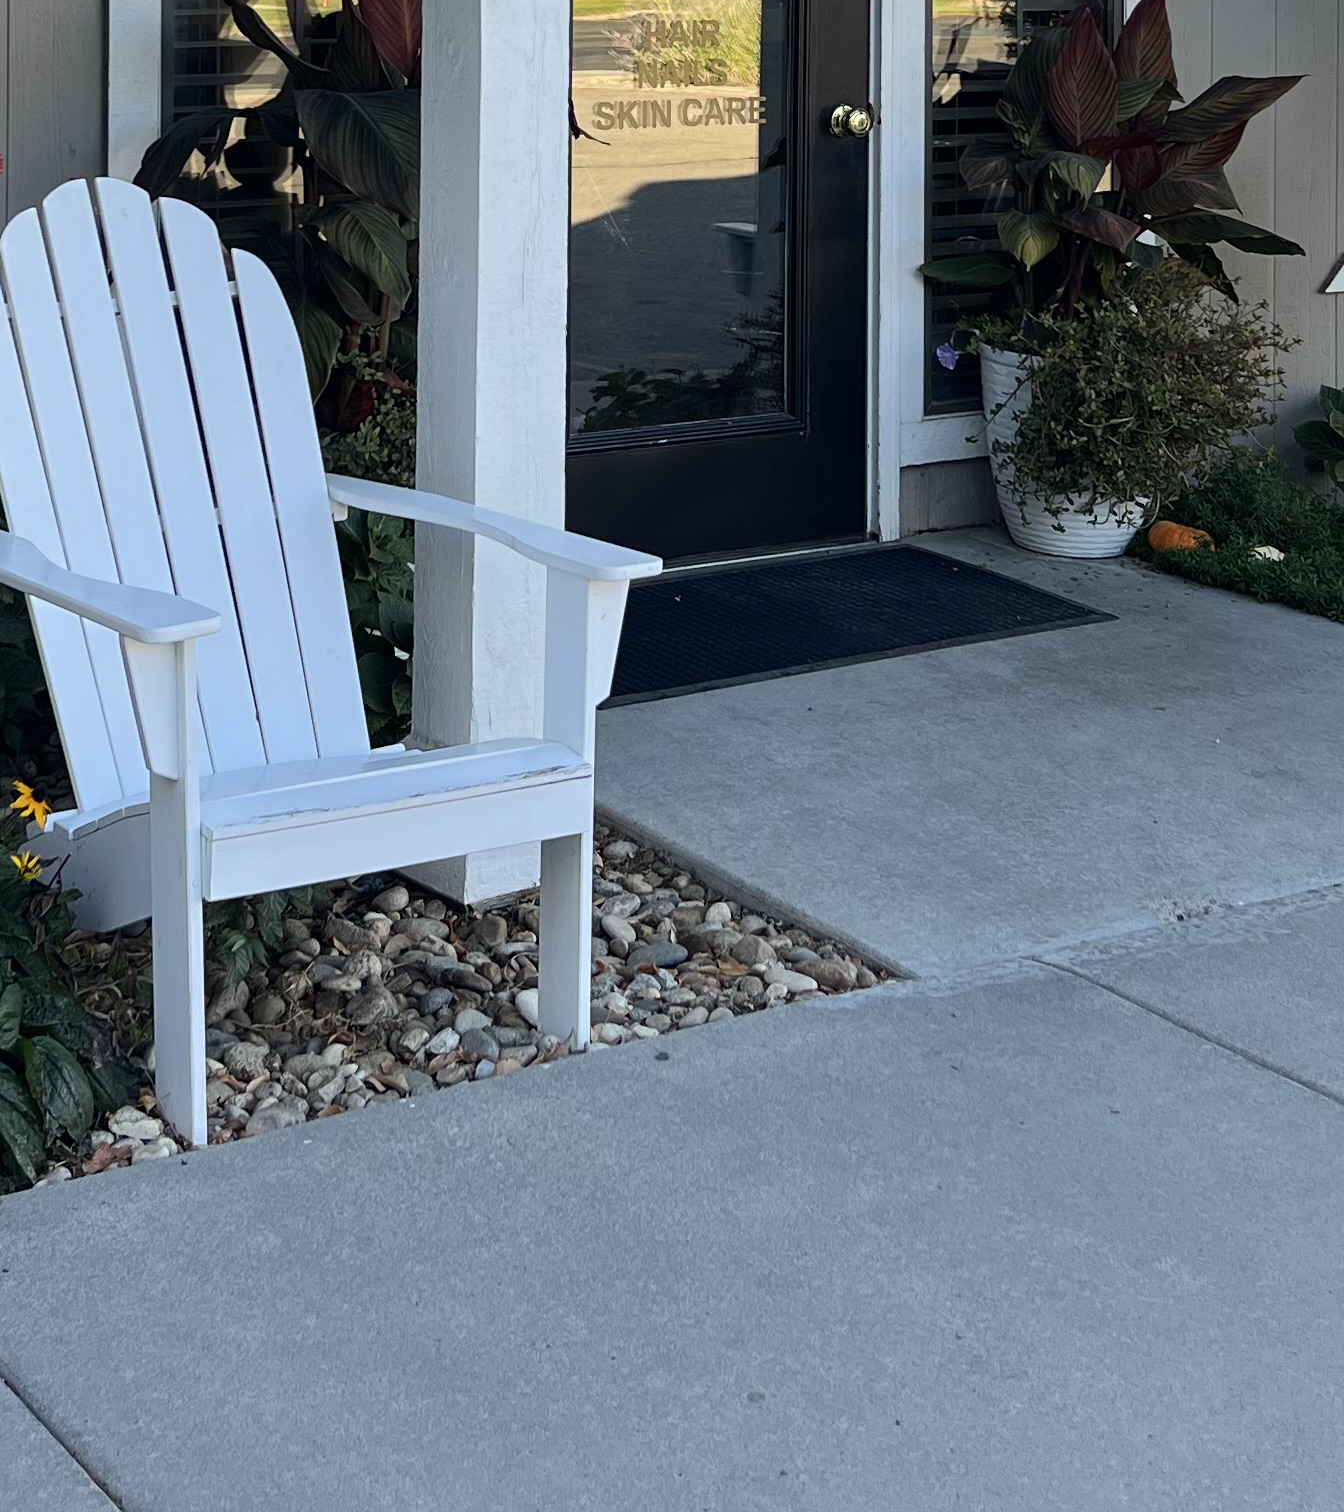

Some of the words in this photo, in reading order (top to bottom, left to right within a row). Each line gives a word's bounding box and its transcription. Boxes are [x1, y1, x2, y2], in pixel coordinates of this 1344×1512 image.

[645, 19, 721, 49] HAIR
[637, 57, 728, 89] NAILS
[595, 99, 672, 130] SKIN
[680, 95, 767, 127] CARE
